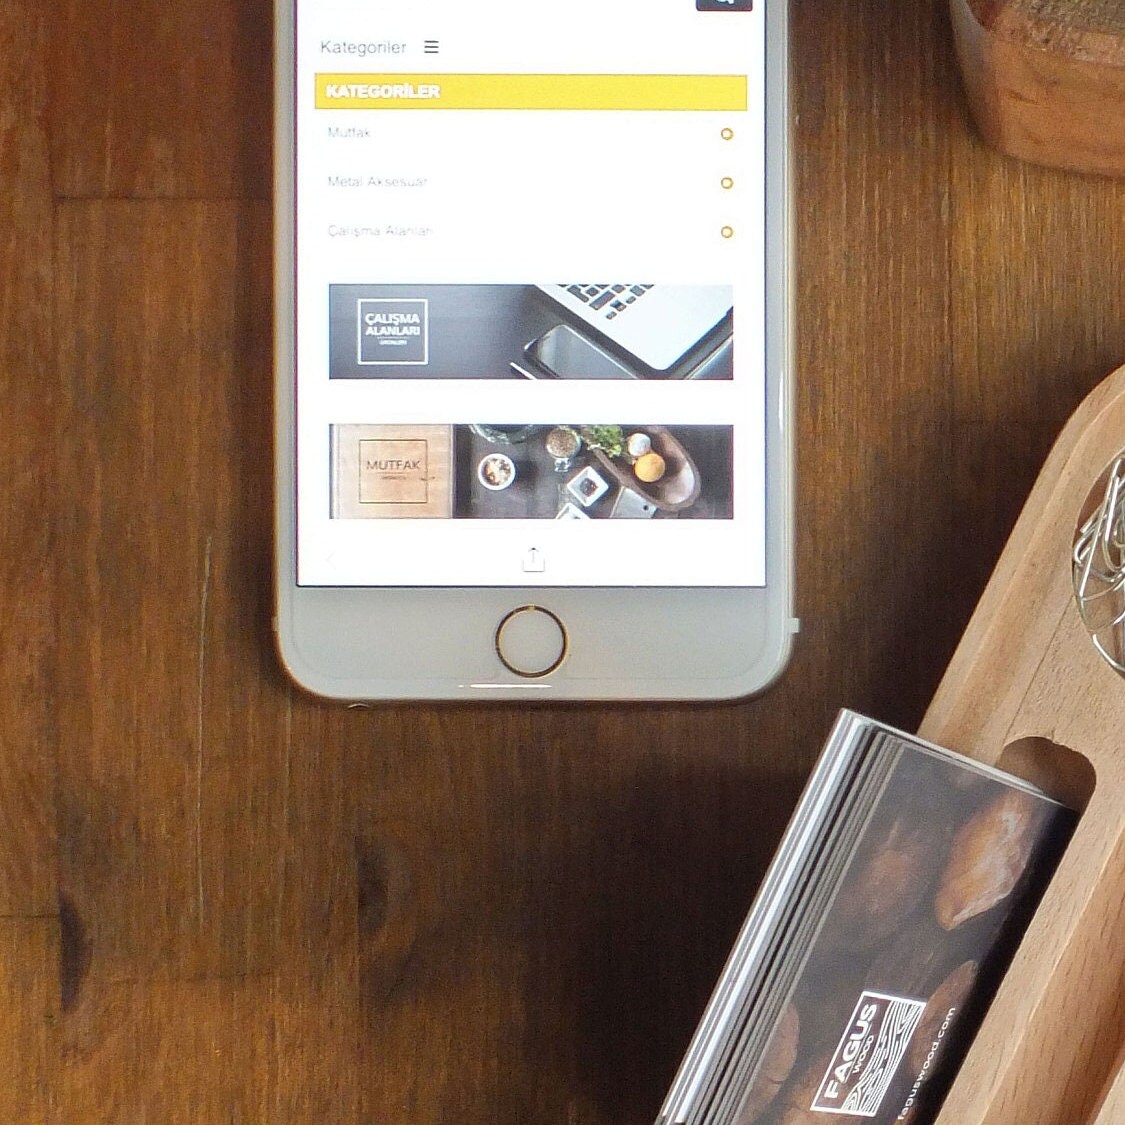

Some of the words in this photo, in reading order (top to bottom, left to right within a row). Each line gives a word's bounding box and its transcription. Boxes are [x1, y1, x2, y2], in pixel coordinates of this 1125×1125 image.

[320, 39, 407, 57] Kategoriler
[328, 127, 370, 138] Mutfak
[328, 176, 362, 187] Metal
[368, 176, 428, 187] Aksesuar
[365, 313, 420, 326] ÇALIŞMA
[365, 326, 420, 335] ALANLARI
[366, 460, 420, 470] MUTFAK
[823, 1003, 877, 1098] FAGUS
[853, 1034, 874, 1074] WOOD
[897, 1007, 956, 1120] faguswood.com
